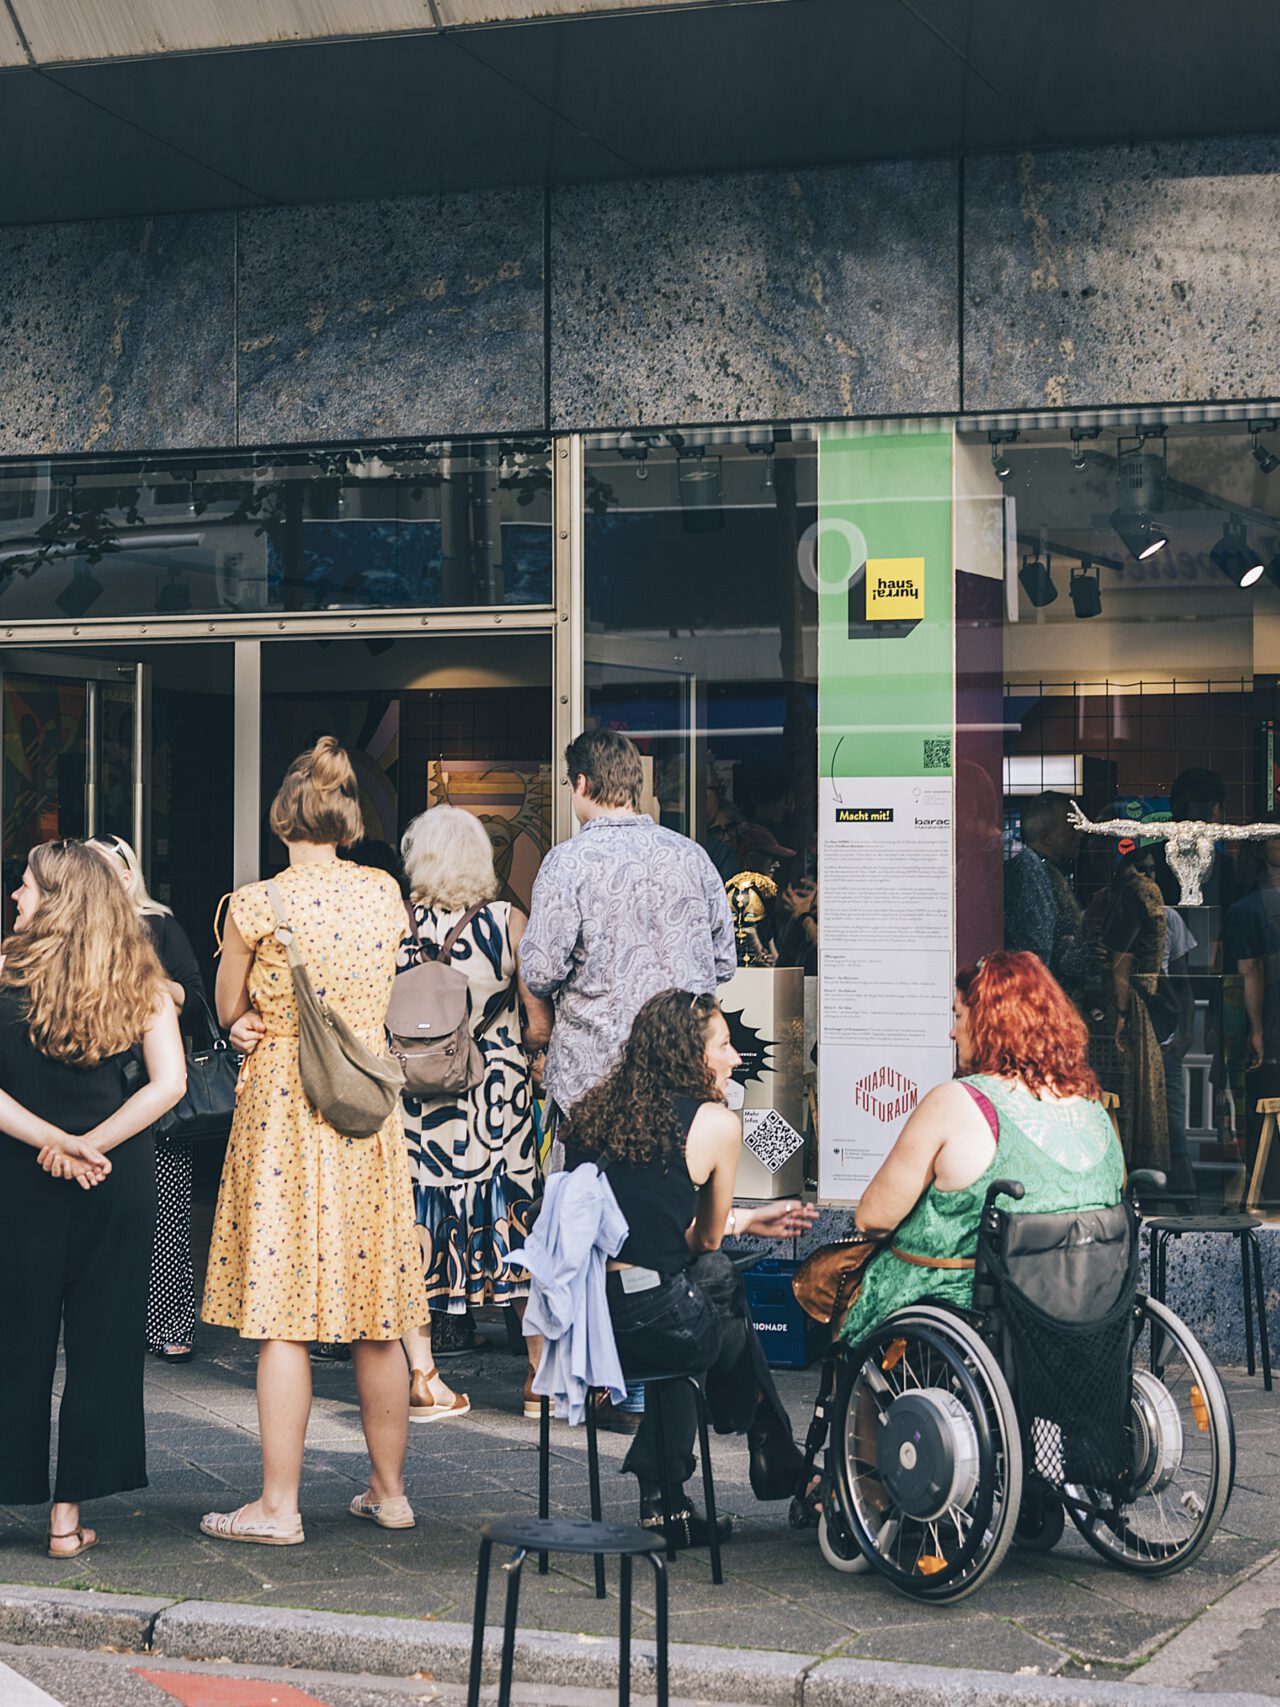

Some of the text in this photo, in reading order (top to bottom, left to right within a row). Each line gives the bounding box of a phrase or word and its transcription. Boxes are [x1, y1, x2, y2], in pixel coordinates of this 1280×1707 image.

[878, 578, 914, 589] haus
[872, 588, 919, 601] hurra!
[839, 810, 890, 821] Macht mit!
[914, 817, 951, 826] barac
[855, 1086, 918, 1123] FUTURAUM
